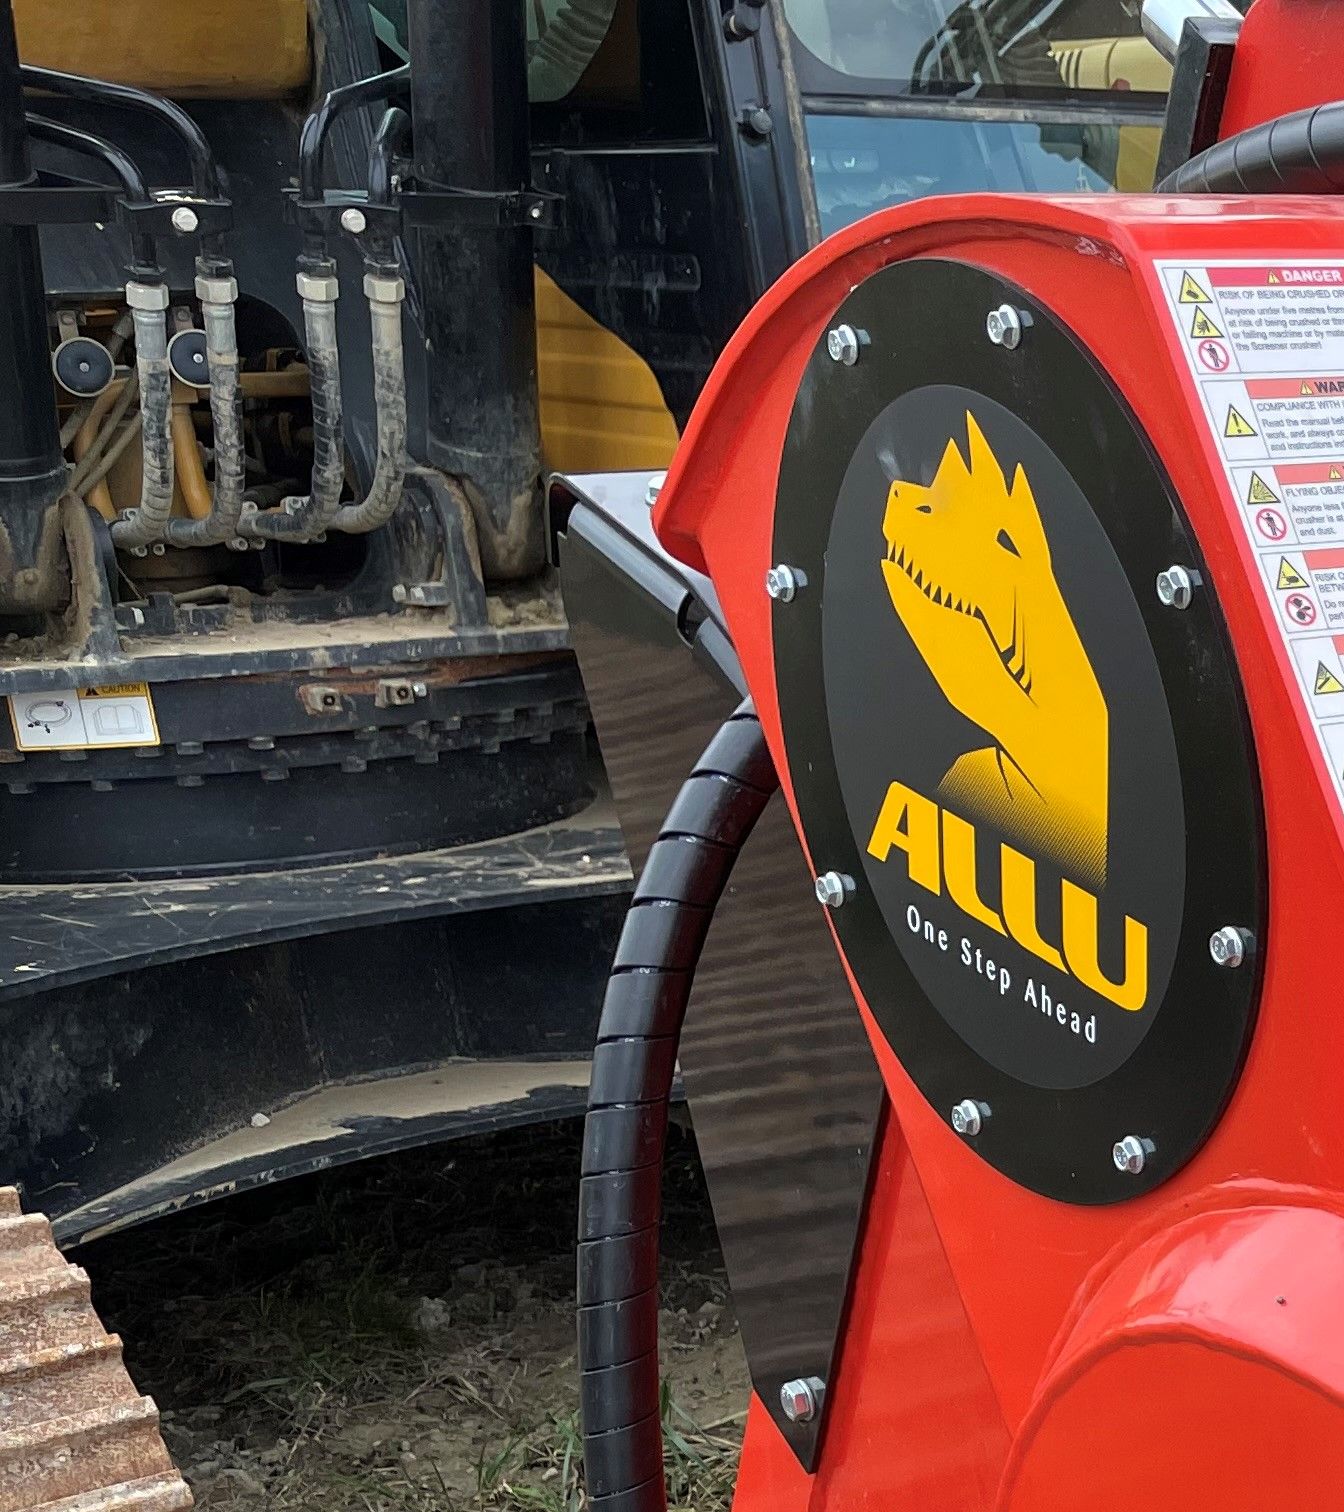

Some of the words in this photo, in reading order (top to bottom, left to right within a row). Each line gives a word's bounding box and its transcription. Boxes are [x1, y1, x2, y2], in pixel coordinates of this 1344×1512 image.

[1282, 270, 1342, 282] DANGER
[1286, 488, 1318, 498] FLYING
[1315, 572, 1335, 582] RISK
[866, 781, 1147, 1011] ALLU
[906, 904, 948, 951] One
[961, 937, 1010, 995] Step
[1024, 978, 1096, 1043] Ahead
